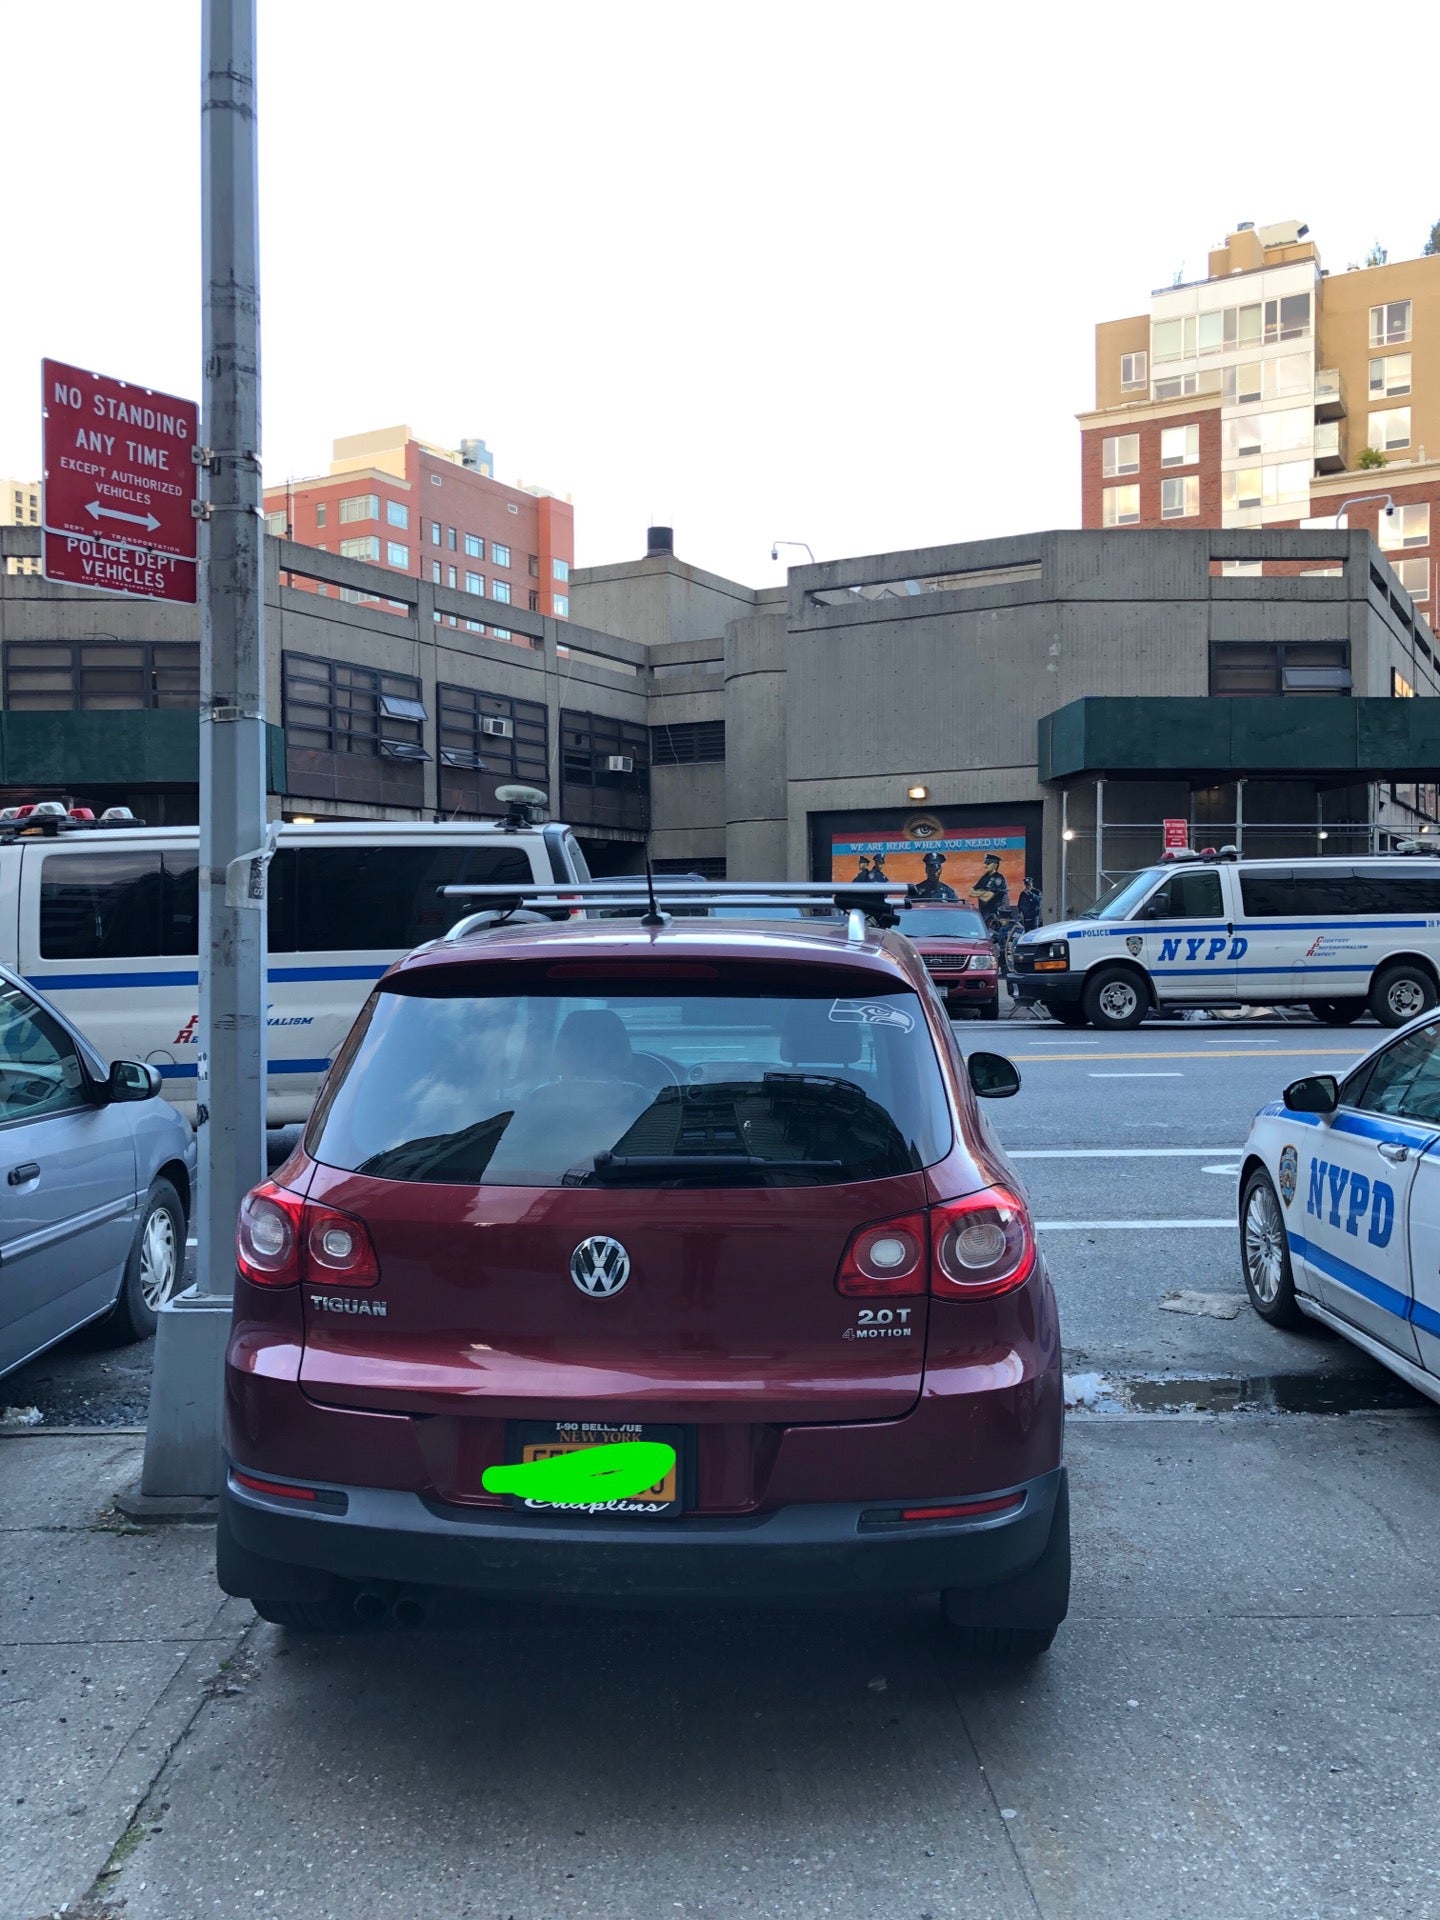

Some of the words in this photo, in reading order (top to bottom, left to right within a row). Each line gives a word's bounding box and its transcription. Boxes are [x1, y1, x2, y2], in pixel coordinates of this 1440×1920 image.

[55, 382, 82, 409] NO
[93, 394, 187, 439] STANDING
[75, 428, 115, 456] ANY
[126, 440, 169, 471] TIME
[60, 456, 106, 478] EXCEPT
[111, 470, 183, 496] AUTHORIZED
[95, 482, 151, 505] VEHICLES
[67, 538, 129, 563] POLICE
[135, 551, 176, 572] DEPT
[82, 558, 165, 589] VEHICLES
[851, 842, 864, 851] WE
[866, 842, 884, 851] ARE
[886, 841, 911, 850] HERE
[914, 840, 941, 849] WHEN
[944, 839, 962, 848] YOU
[965, 838, 991, 847] NEED
[993, 837, 1007, 846] US
[1081, 929, 1110, 937] POLICE
[1157, 937, 1248, 962] NYPD
[1307, 1157, 1395, 1249] NYPD
[310, 1295, 388, 1316] TIGUAN
[556, 1423, 579, 1431] I-90
[582, 1423, 643, 1433] BELLVUE
[559, 1430, 596, 1443] NEW
[602, 1431, 642, 1443] YORK
